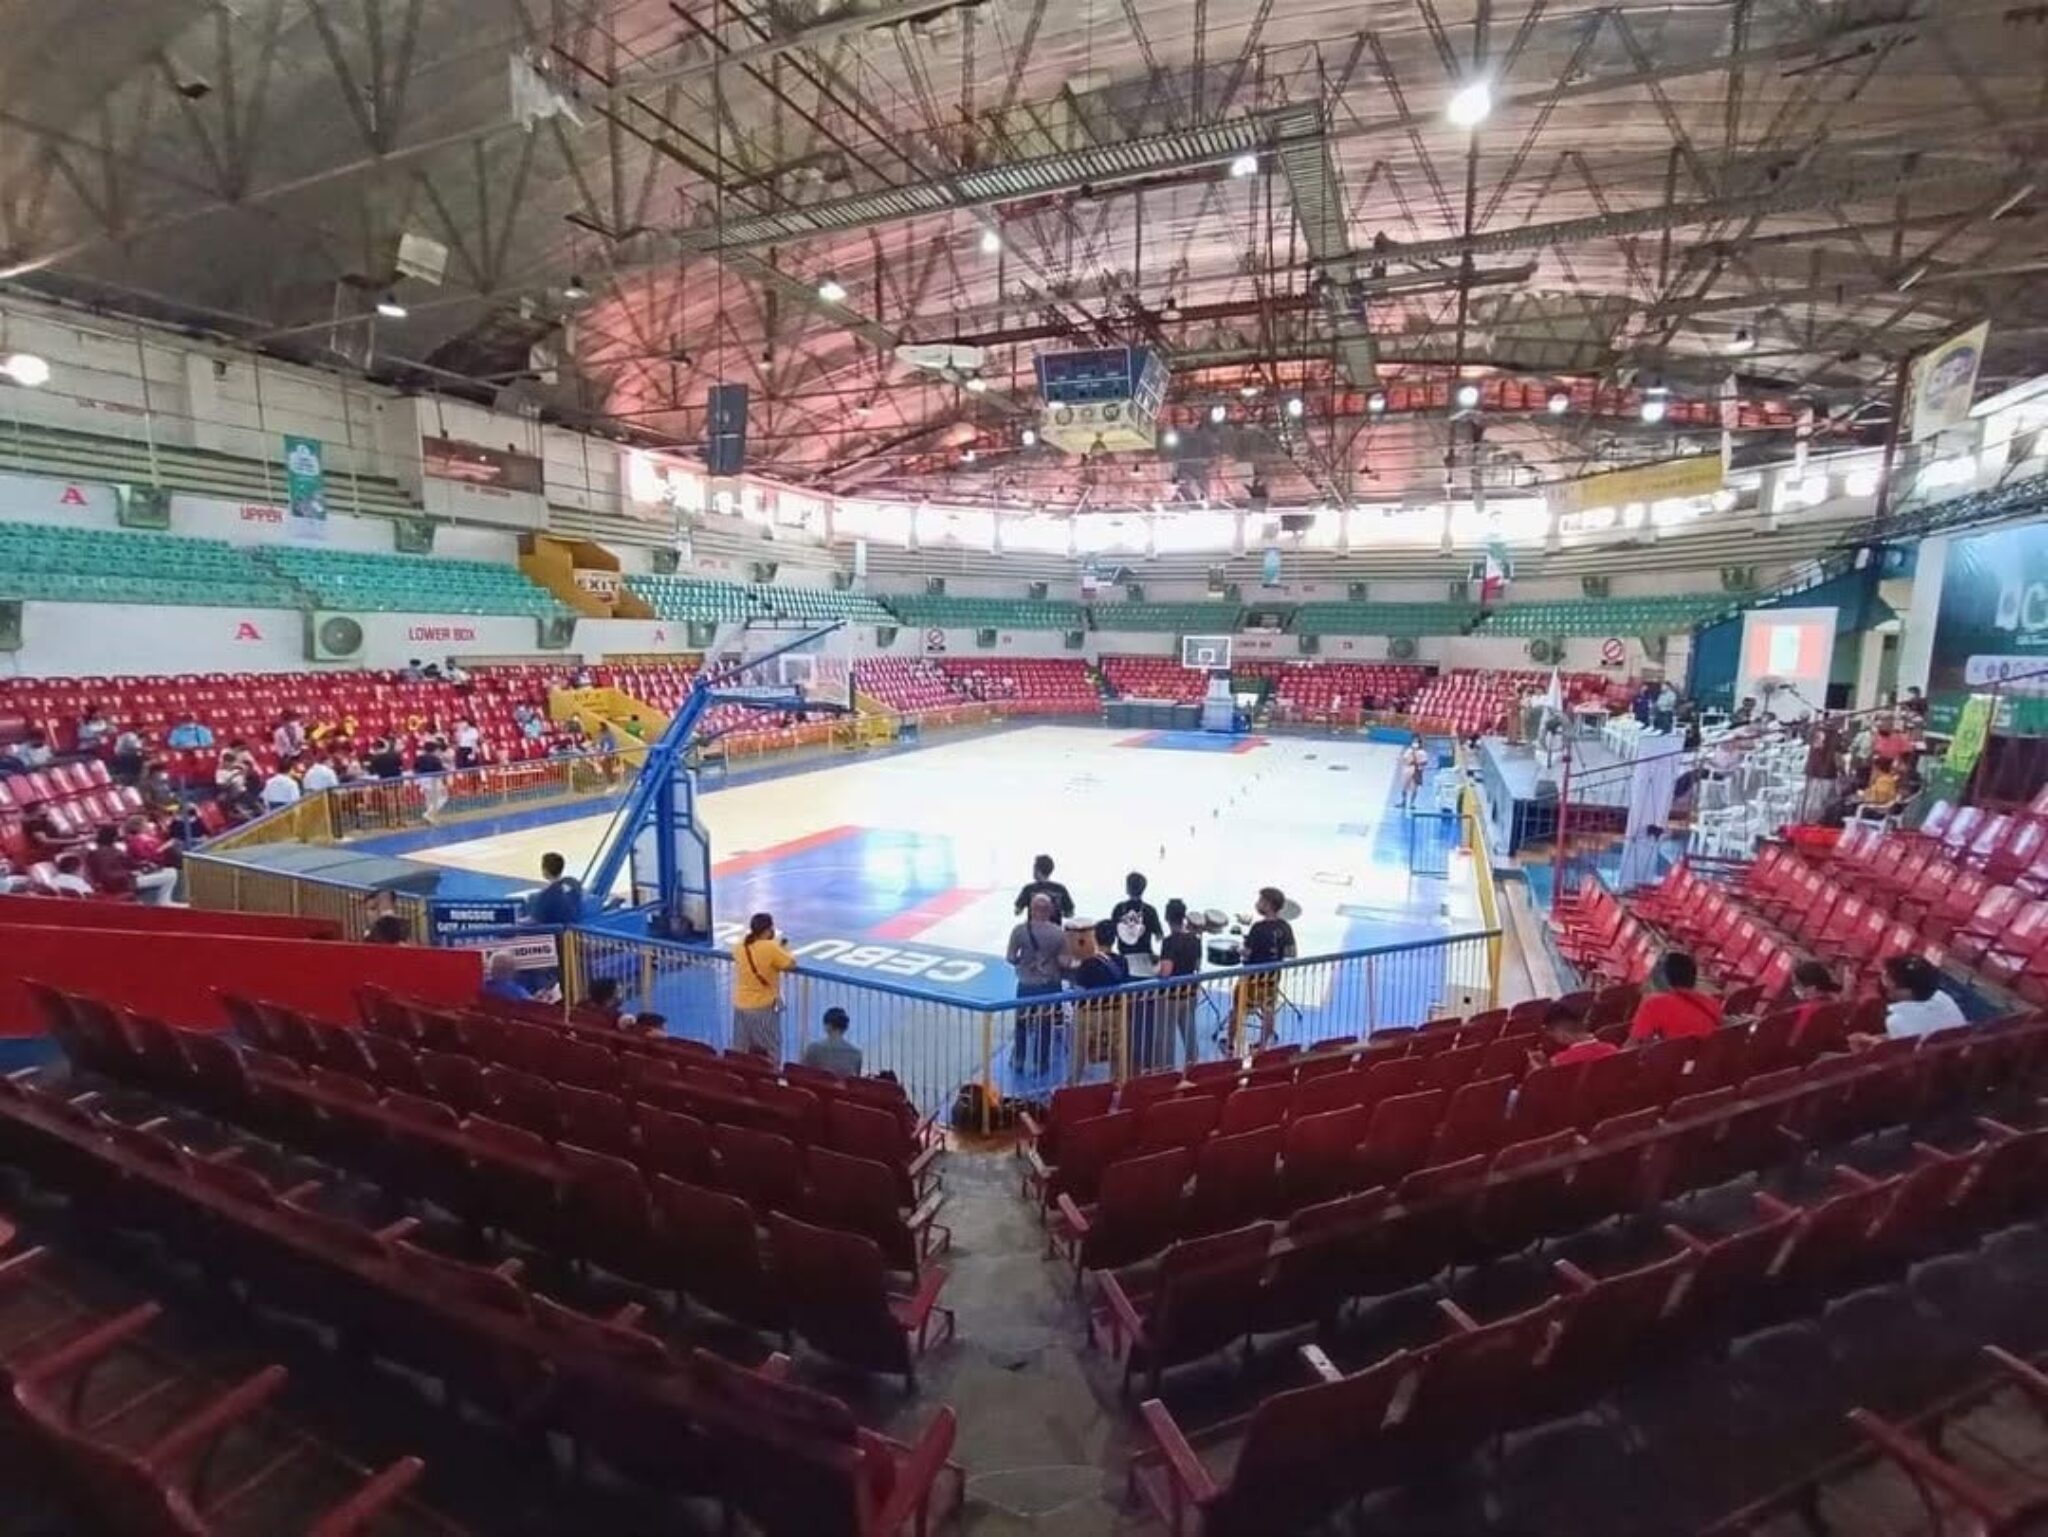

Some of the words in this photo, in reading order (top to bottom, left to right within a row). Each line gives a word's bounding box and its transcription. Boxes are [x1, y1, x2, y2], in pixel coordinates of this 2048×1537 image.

[60, 486, 88, 505] A
[240, 503, 283, 523] UPPER
[576, 578, 618, 591] EXIT
[234, 622, 262, 641] A
[408, 626, 450, 641] LOWER
[453, 627, 476, 641] BOX
[792, 939, 986, 982] CEBU
